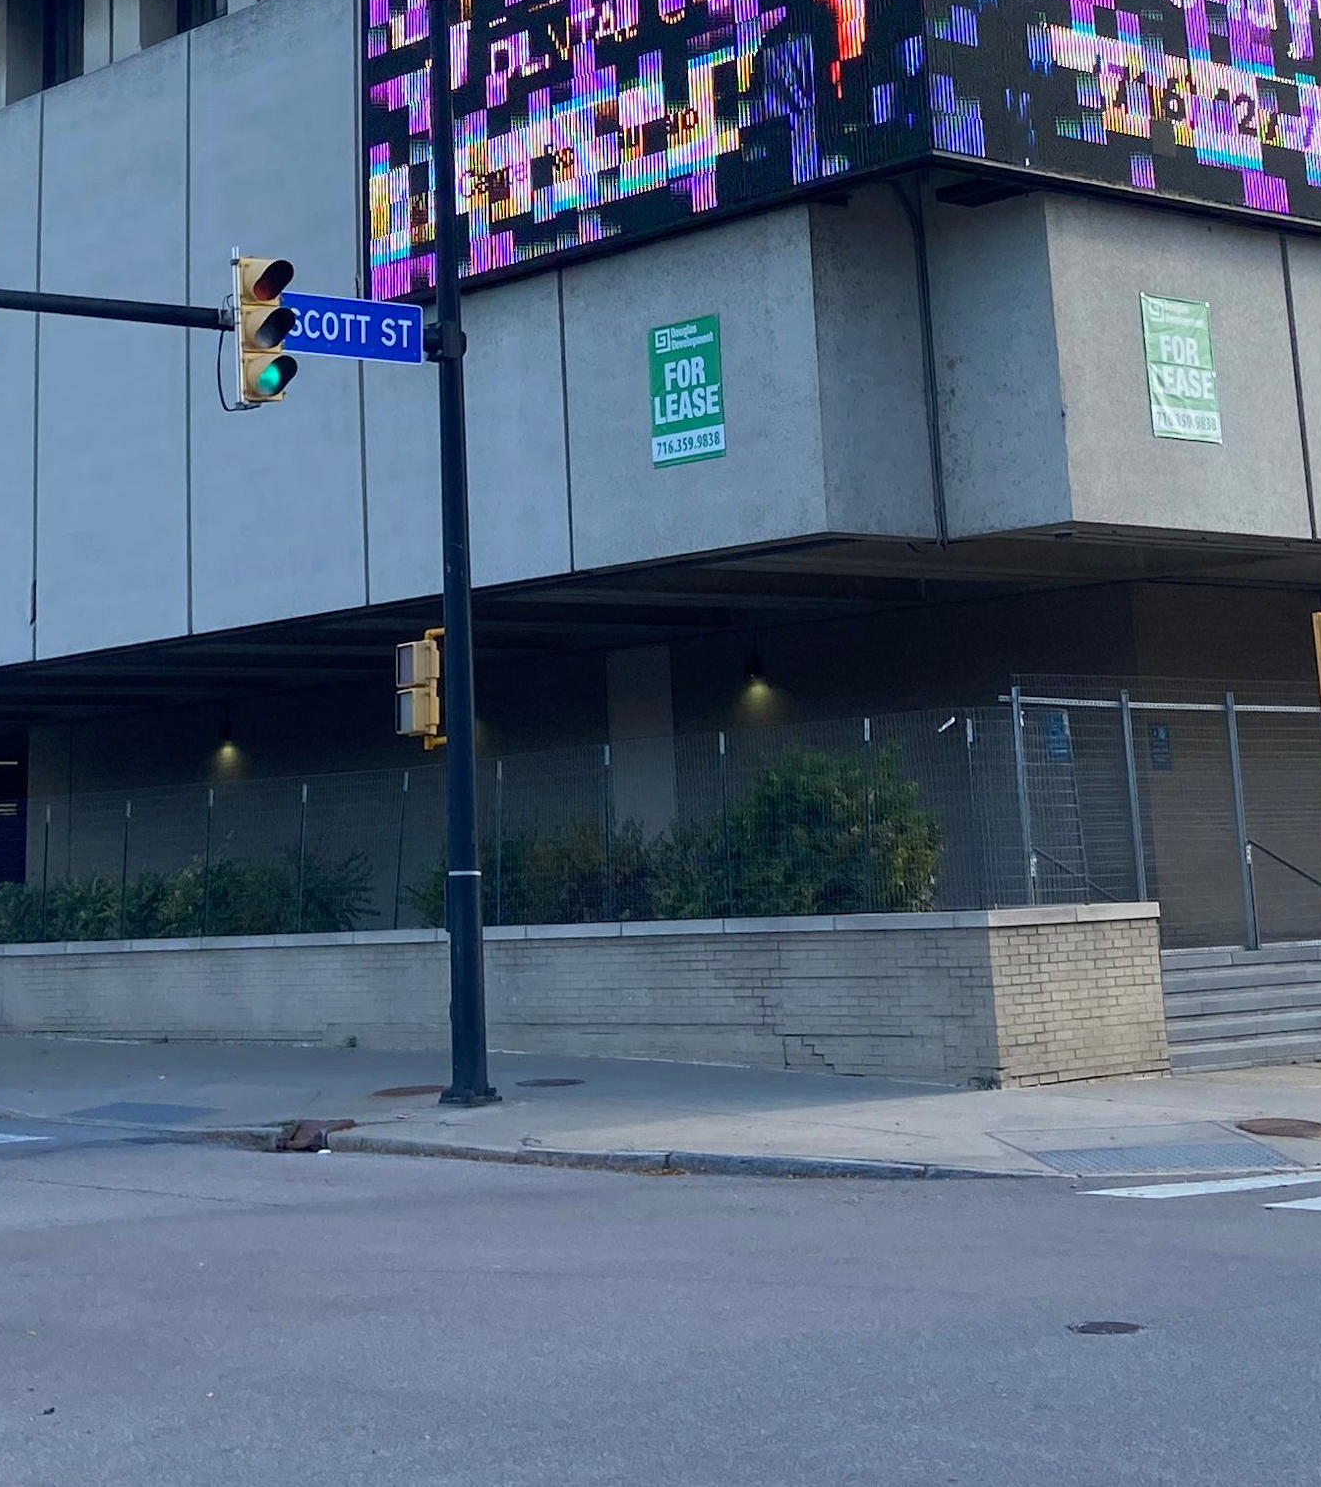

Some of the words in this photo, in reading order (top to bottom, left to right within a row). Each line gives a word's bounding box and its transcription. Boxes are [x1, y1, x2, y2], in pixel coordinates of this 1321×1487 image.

[288, 307, 371, 344] SCOTT
[381, 318, 412, 348] ST
[1160, 334, 1198, 366] FOR
[664, 356, 706, 391] FOR
[654, 383, 720, 425] LEASE
[657, 431, 720, 456] 716.359.9838
